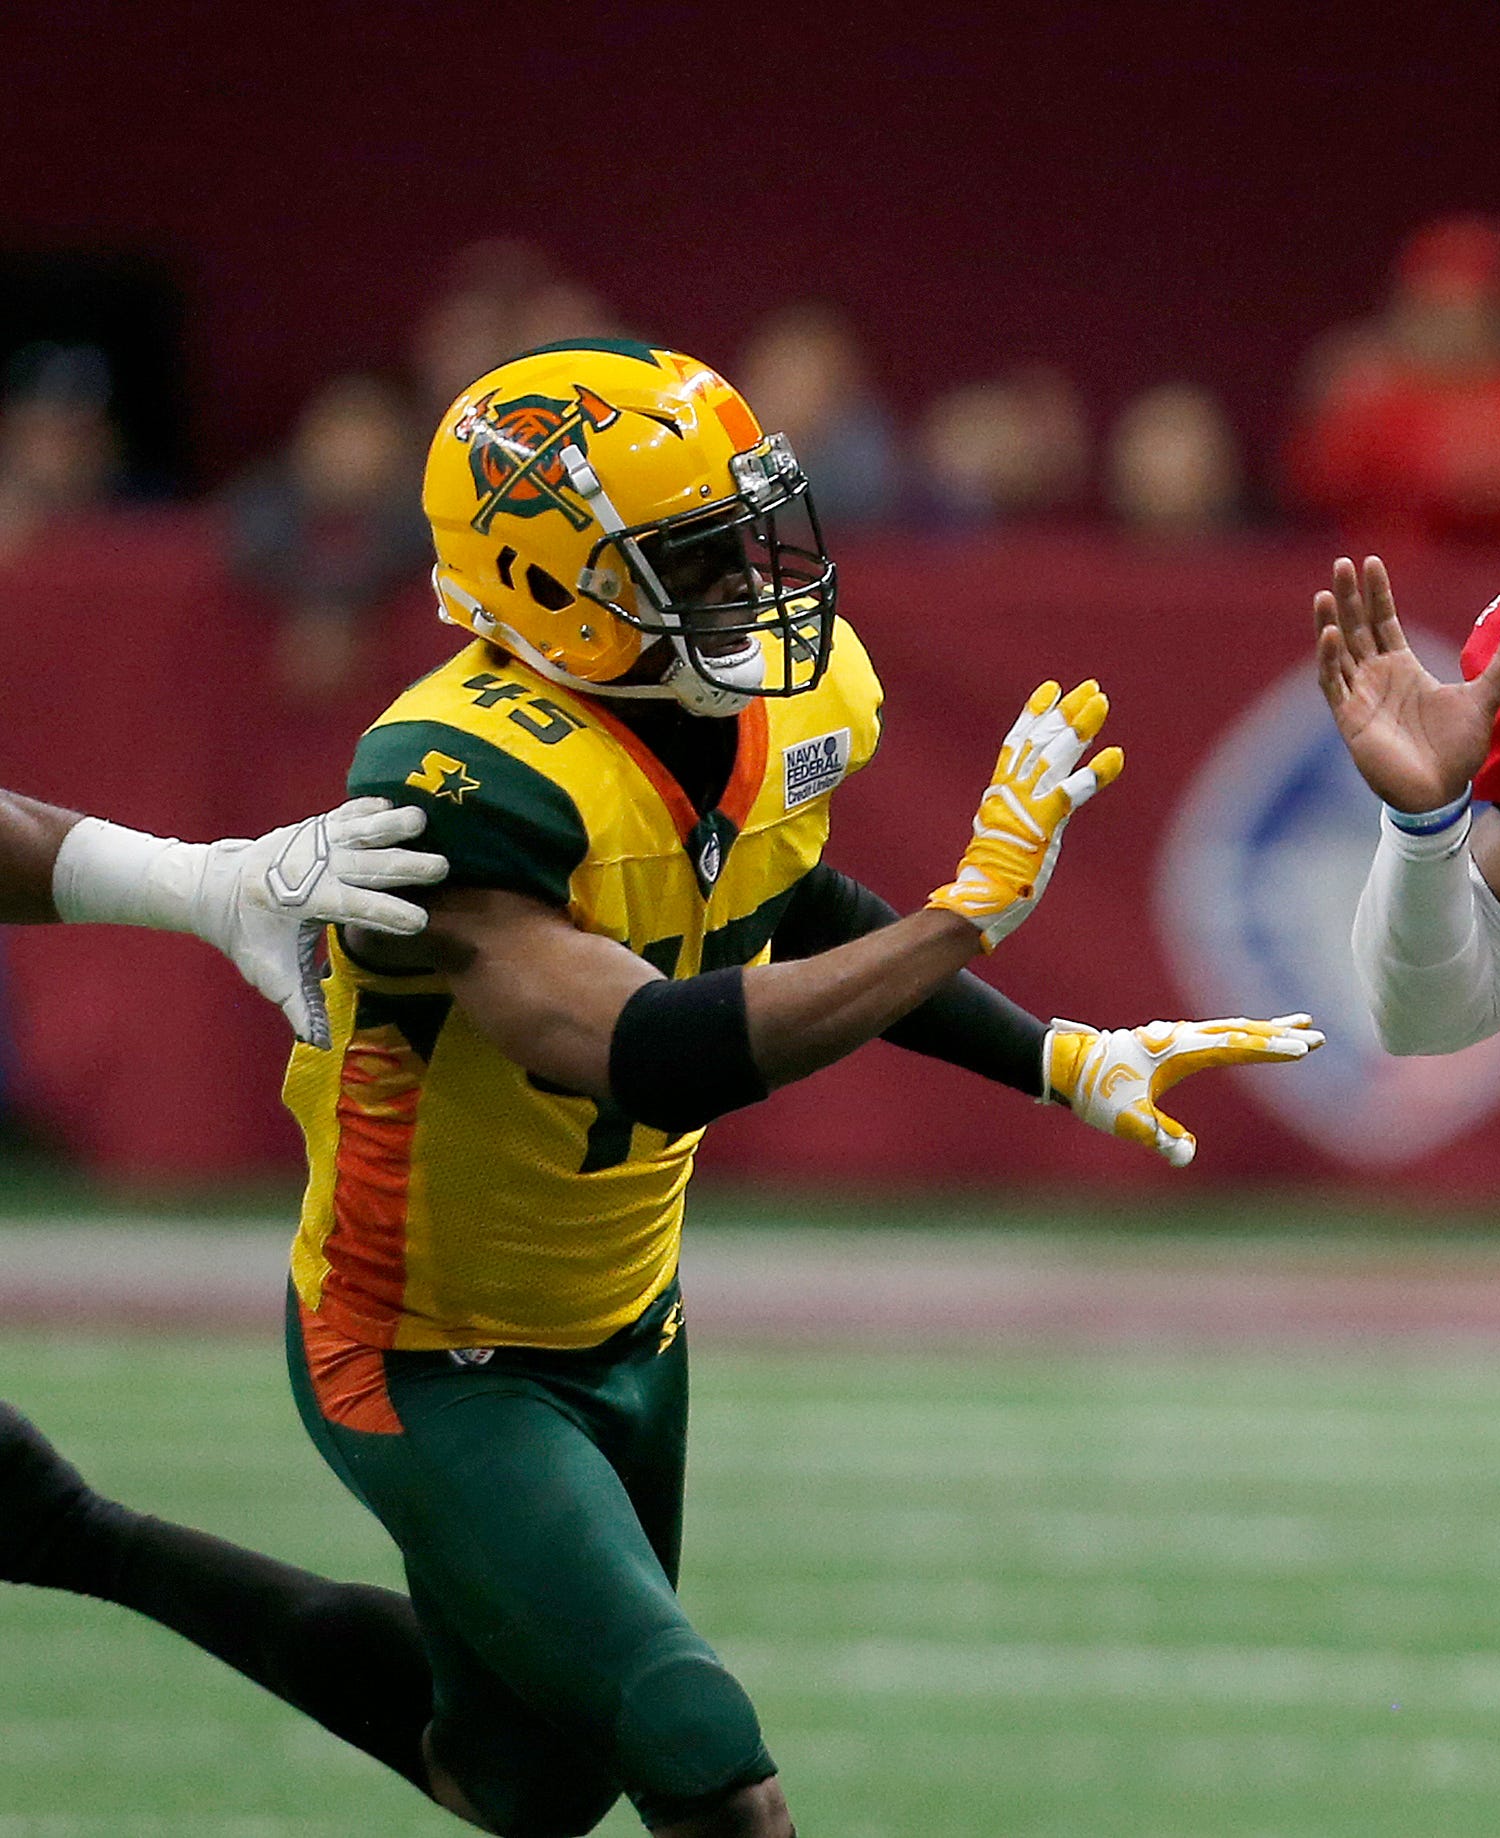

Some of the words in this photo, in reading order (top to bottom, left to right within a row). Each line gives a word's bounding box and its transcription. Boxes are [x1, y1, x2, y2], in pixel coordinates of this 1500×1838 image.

[462, 672, 588, 745] 45
[787, 742, 821, 769] NAVY
[787, 753, 842, 785] FEDERAL
